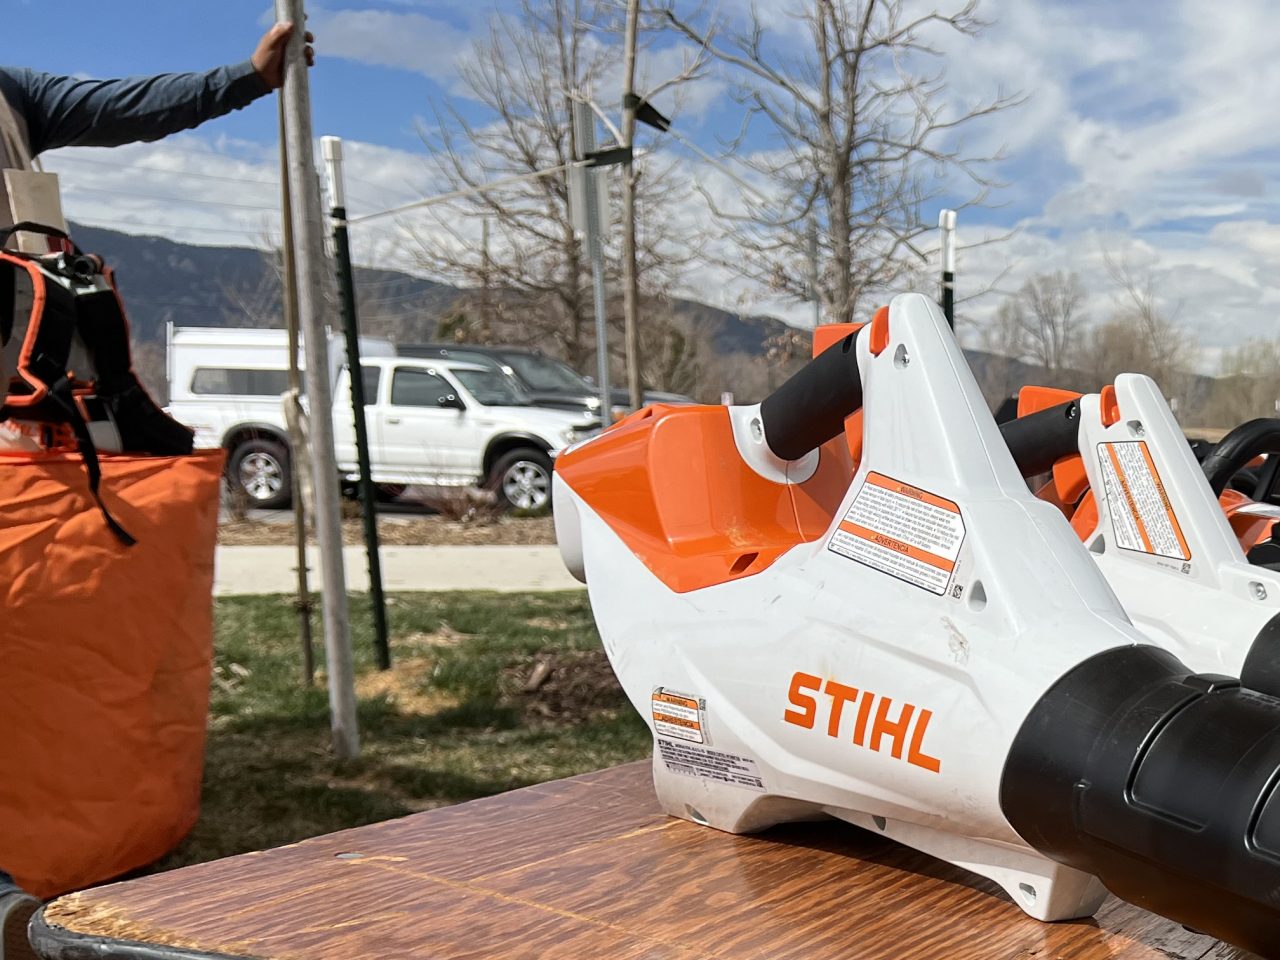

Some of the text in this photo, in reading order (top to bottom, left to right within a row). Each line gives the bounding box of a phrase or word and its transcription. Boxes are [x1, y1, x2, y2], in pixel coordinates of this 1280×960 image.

[900, 486, 923, 499] WARNING
[875, 534, 909, 553] ADVERTENCIA
[784, 671, 941, 774] STIHL
